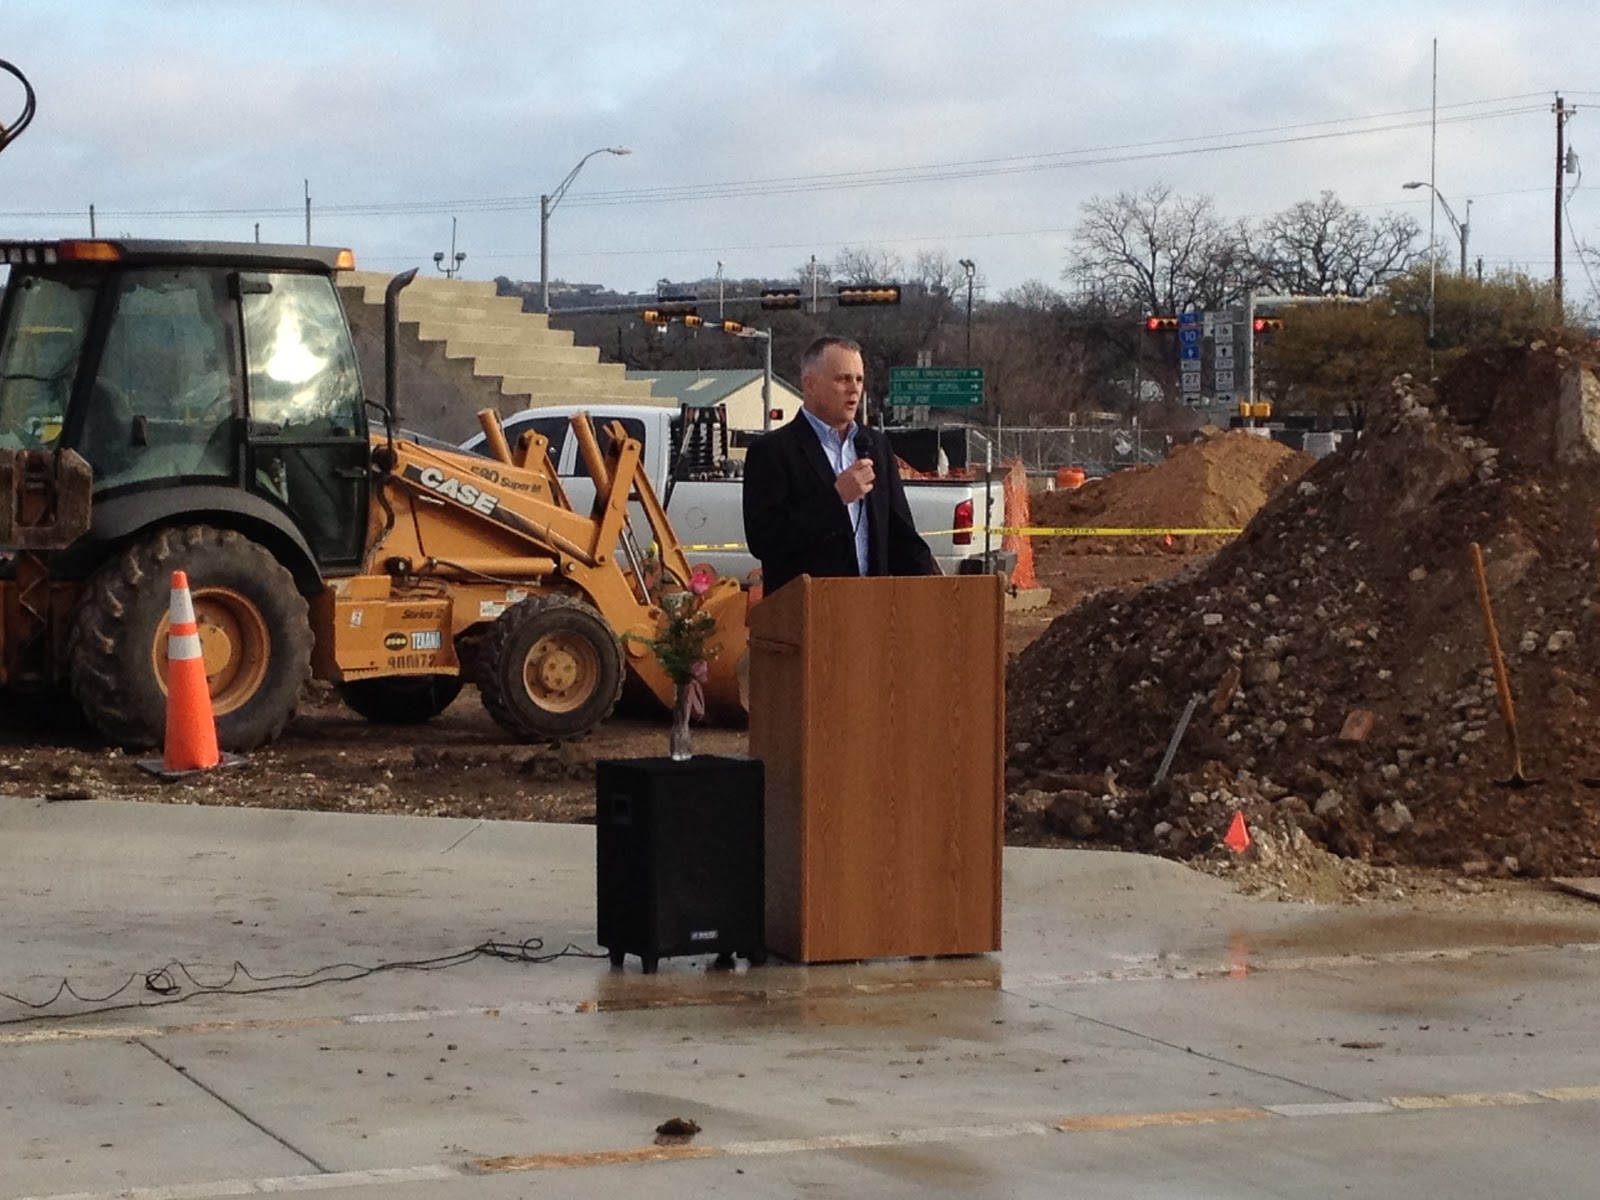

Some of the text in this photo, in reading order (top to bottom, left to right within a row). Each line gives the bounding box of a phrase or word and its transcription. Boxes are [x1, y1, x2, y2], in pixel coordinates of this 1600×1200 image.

[1184, 331, 1197, 342] 10
[1184, 373, 1199, 384] 27
[501, 477, 529, 491] Super
[420, 467, 499, 515] CASE
